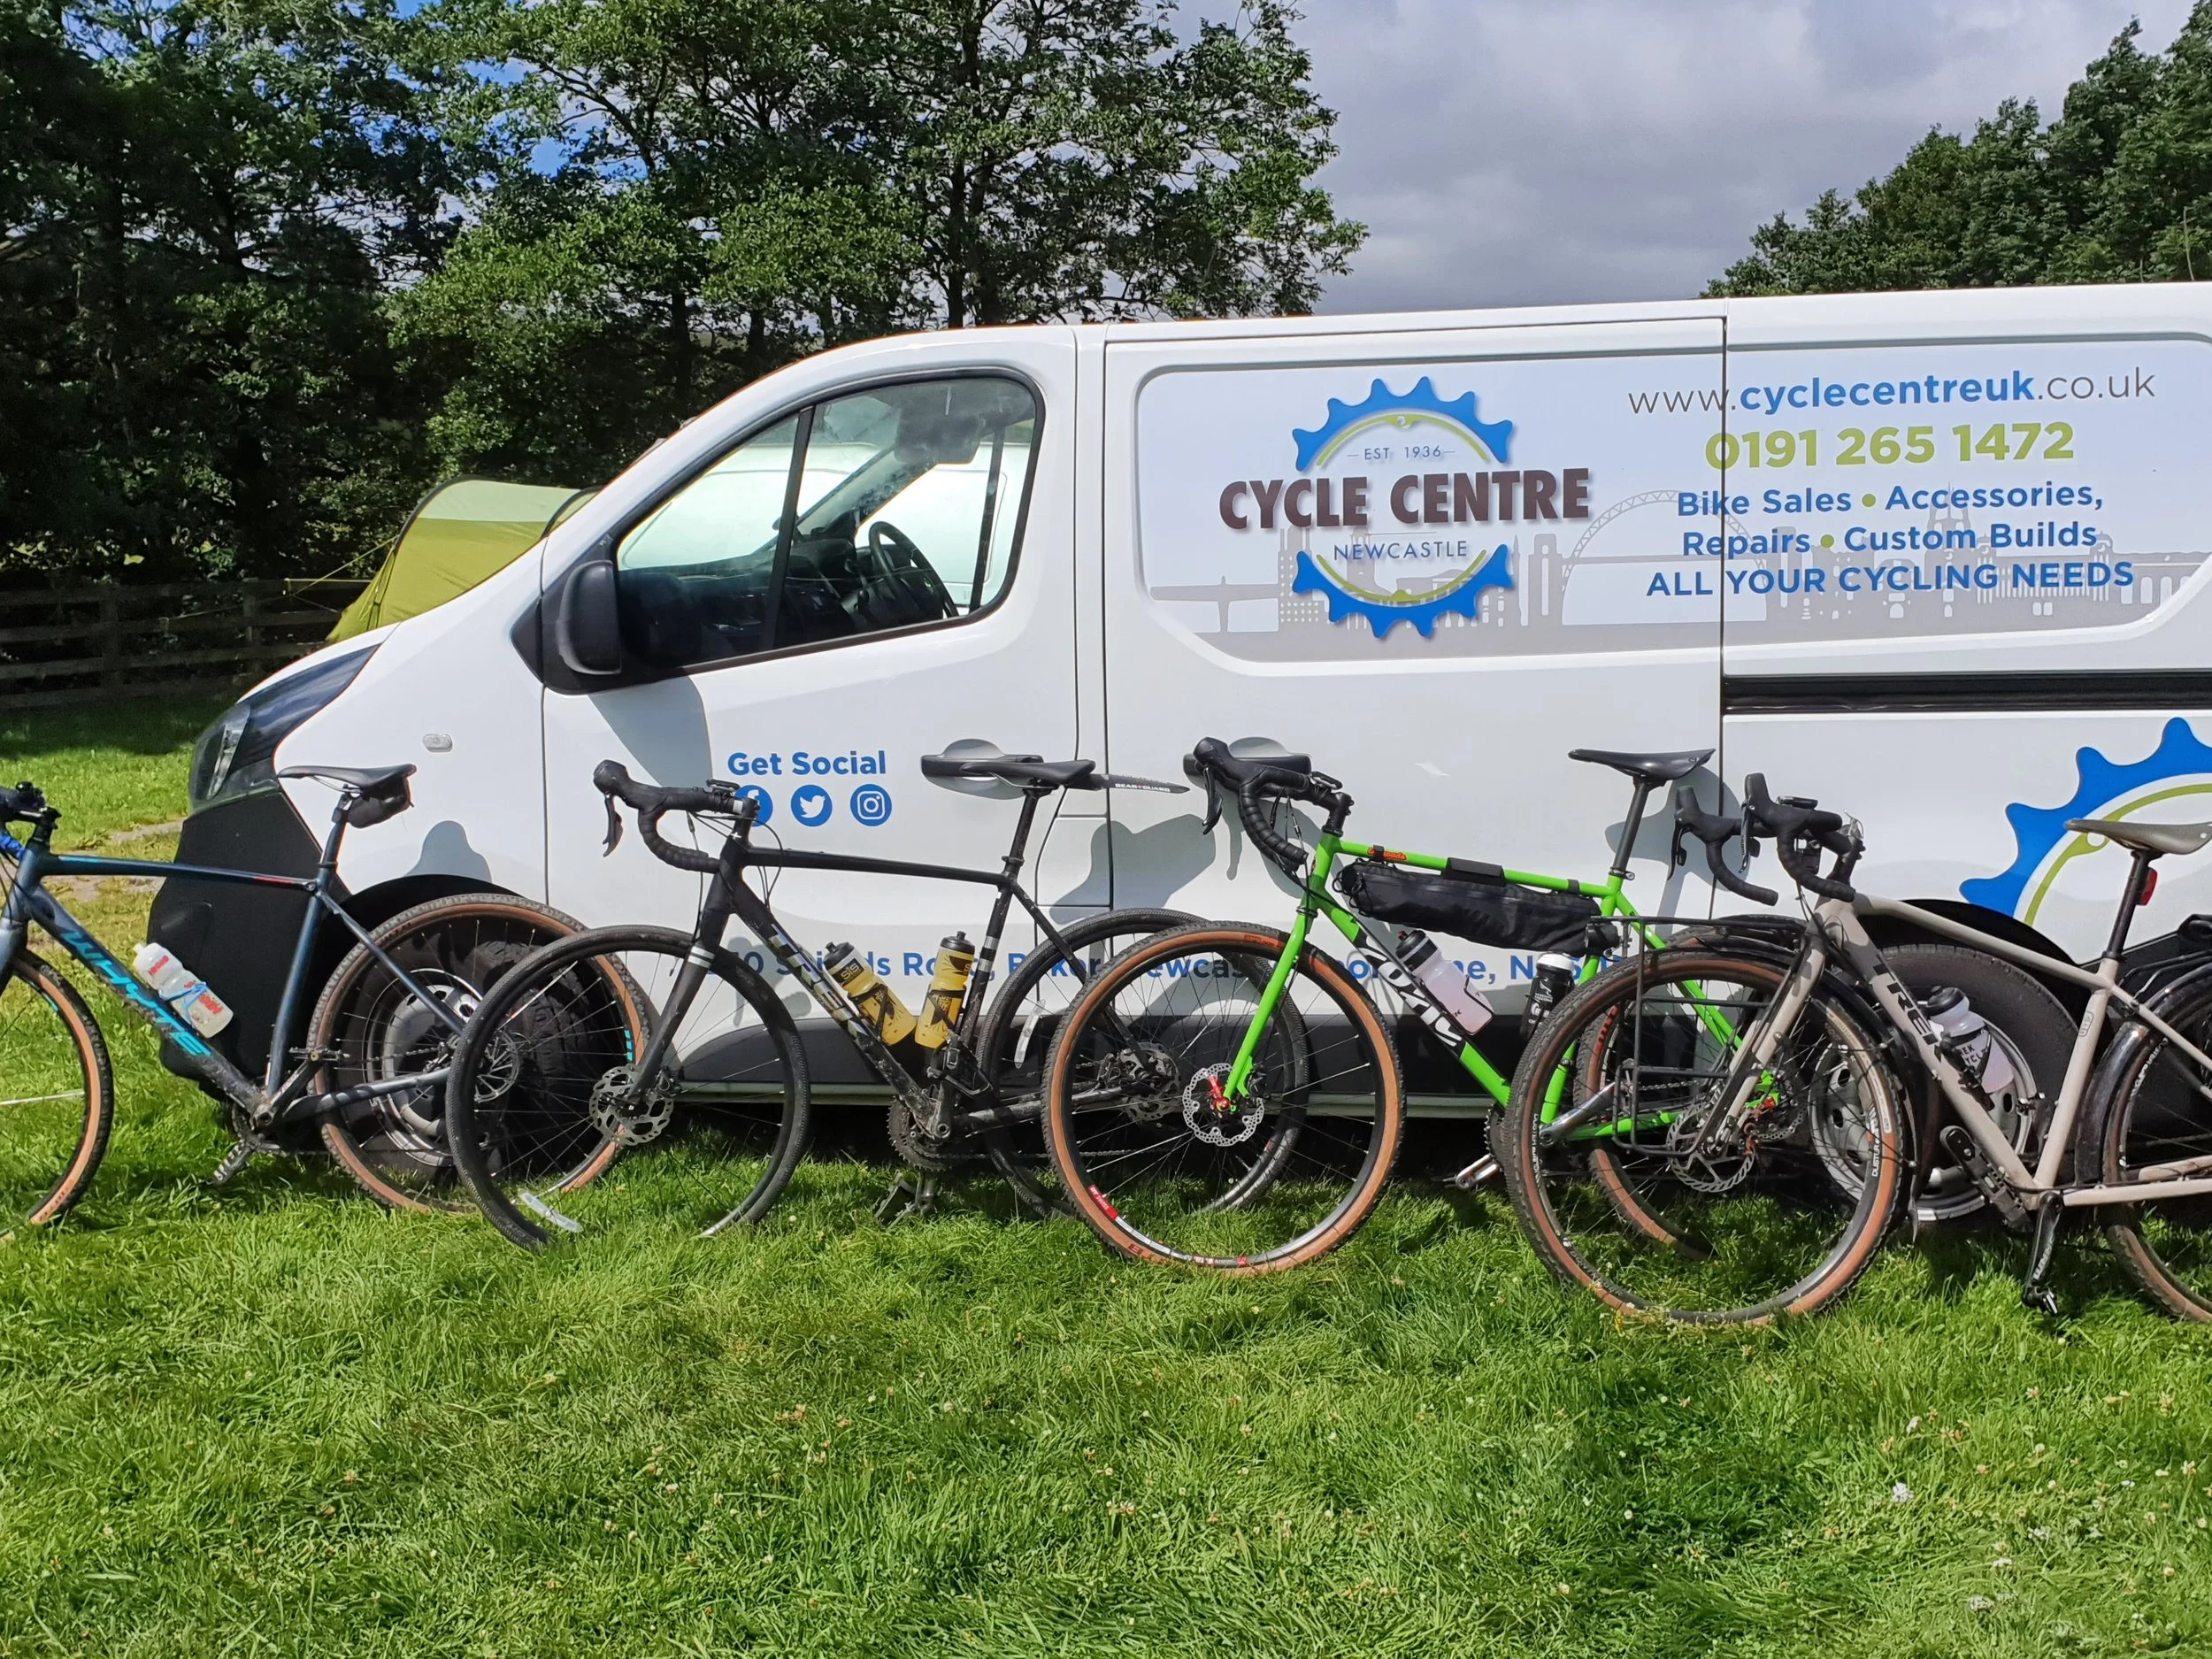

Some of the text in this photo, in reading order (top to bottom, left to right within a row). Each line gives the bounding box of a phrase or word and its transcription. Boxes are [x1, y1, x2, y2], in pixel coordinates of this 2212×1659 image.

[1628, 366, 2156, 416] www.cyclecentreuk.co.uk
[1363, 444, 1442, 461] EST 1936
[1705, 421, 2075, 470] 0191 265 1472
[1219, 467, 1590, 531] CYCLE CENTRE
[1678, 480, 2104, 517] Bike Sales Accessories,
[1333, 540, 1469, 562] NEWCASTLE
[1682, 520, 2098, 560] Repairs Custom Builds
[1647, 561, 2134, 597] ALL YOUR CYCLING NEEDS
[727, 750, 887, 776] Get Social
[61, 933, 213, 1056] WHYTE
[770, 923, 868, 1041] TREK
[1873, 954, 1943, 1064] TREK
